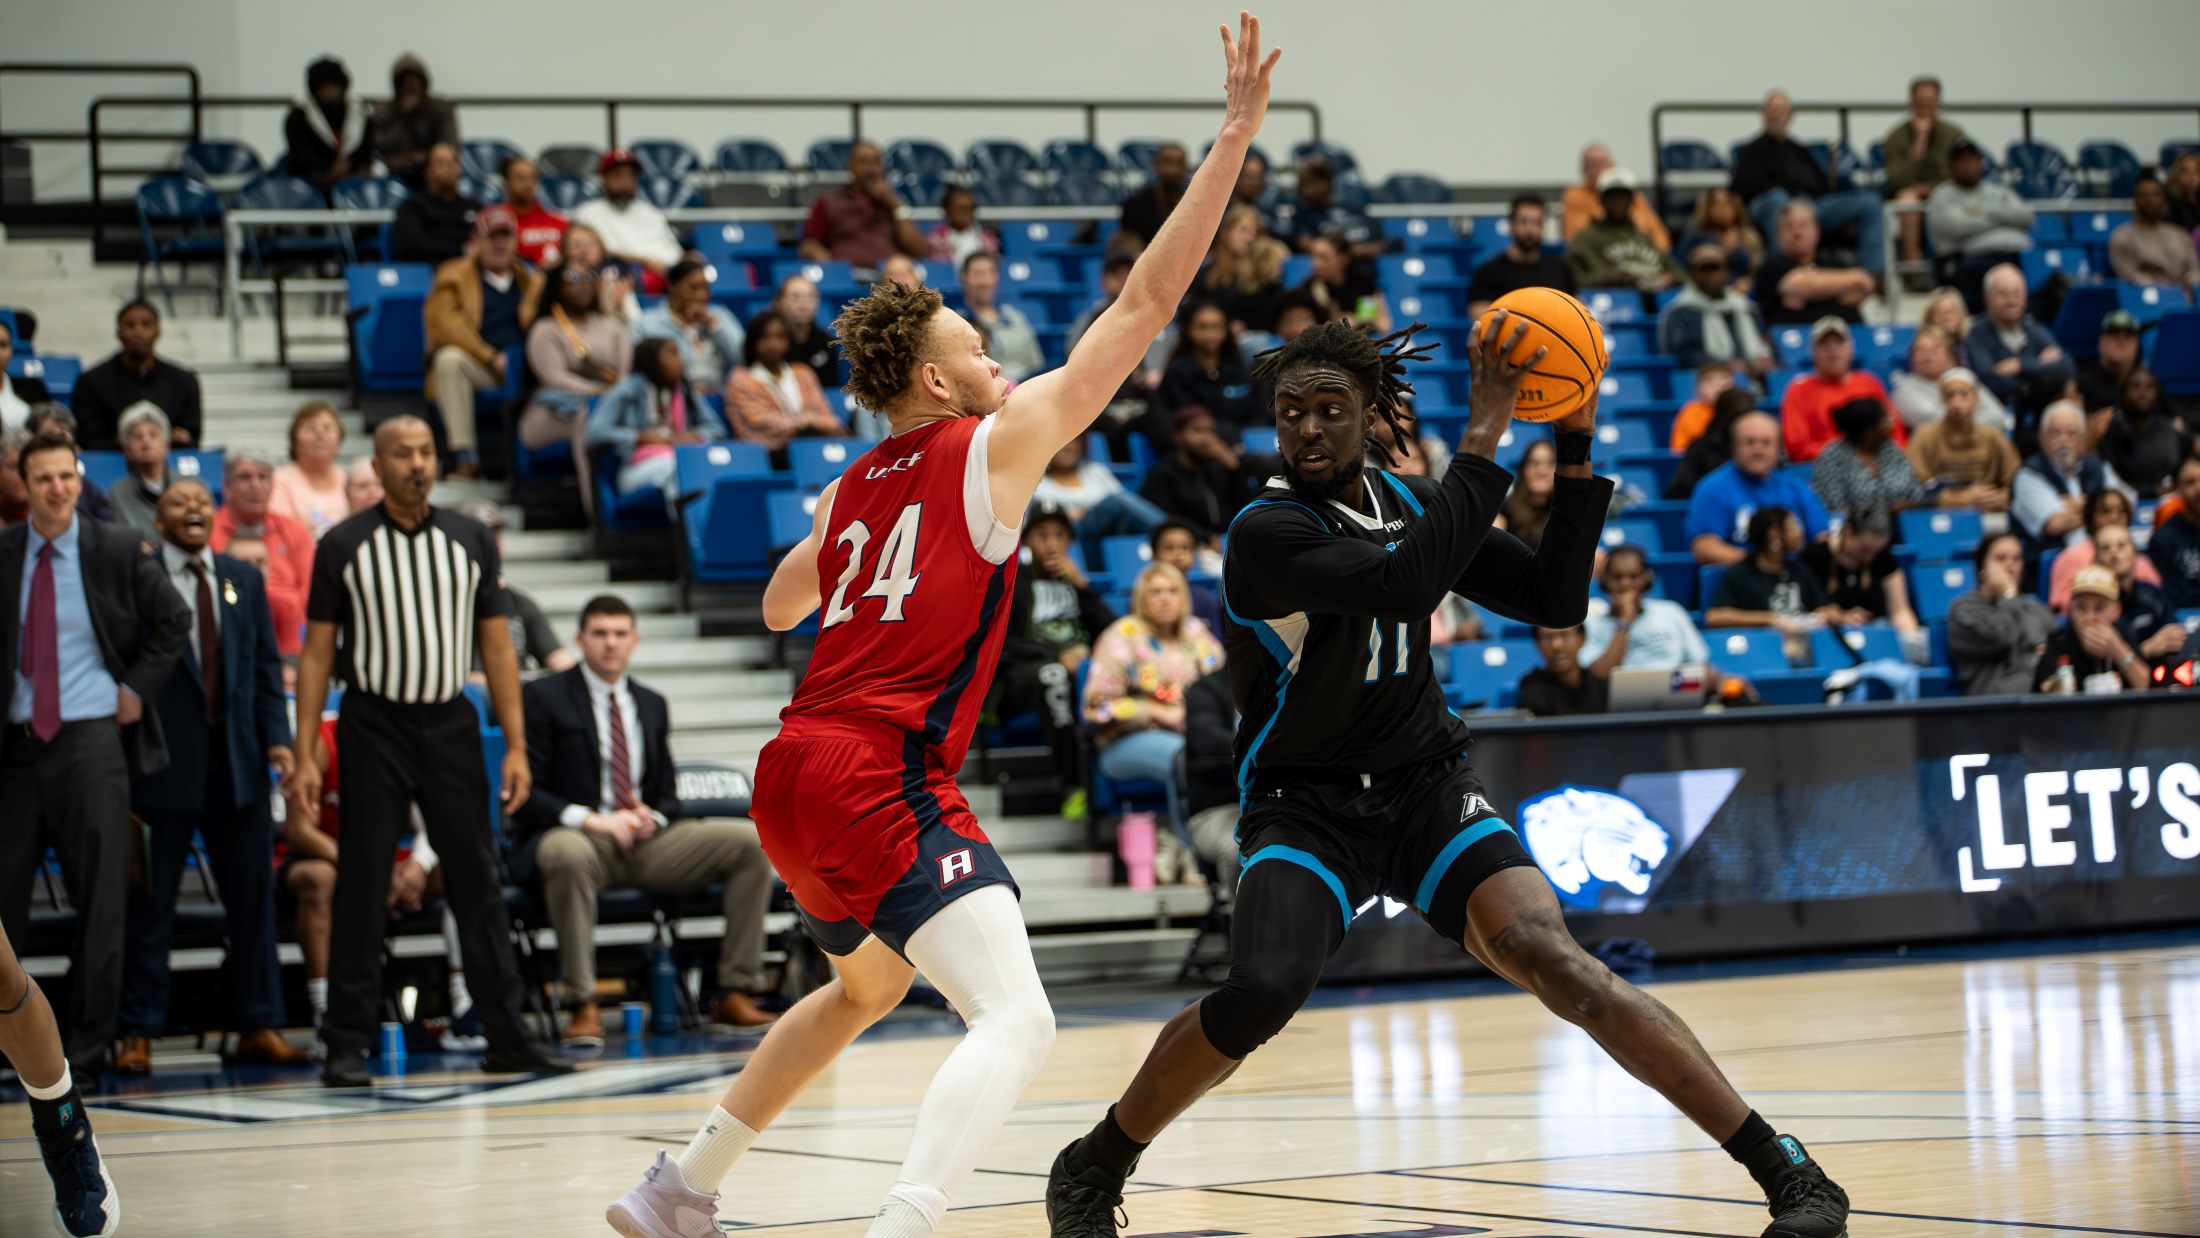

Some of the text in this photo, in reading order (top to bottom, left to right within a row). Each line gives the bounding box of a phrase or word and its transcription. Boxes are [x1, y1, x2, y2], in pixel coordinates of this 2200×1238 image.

[822, 500, 924, 630] 24
[1364, 617, 1409, 684] 11
[676, 770, 751, 800] UGUSTA
[1975, 761, 2200, 870] LET'S
[934, 847, 976, 890] A
